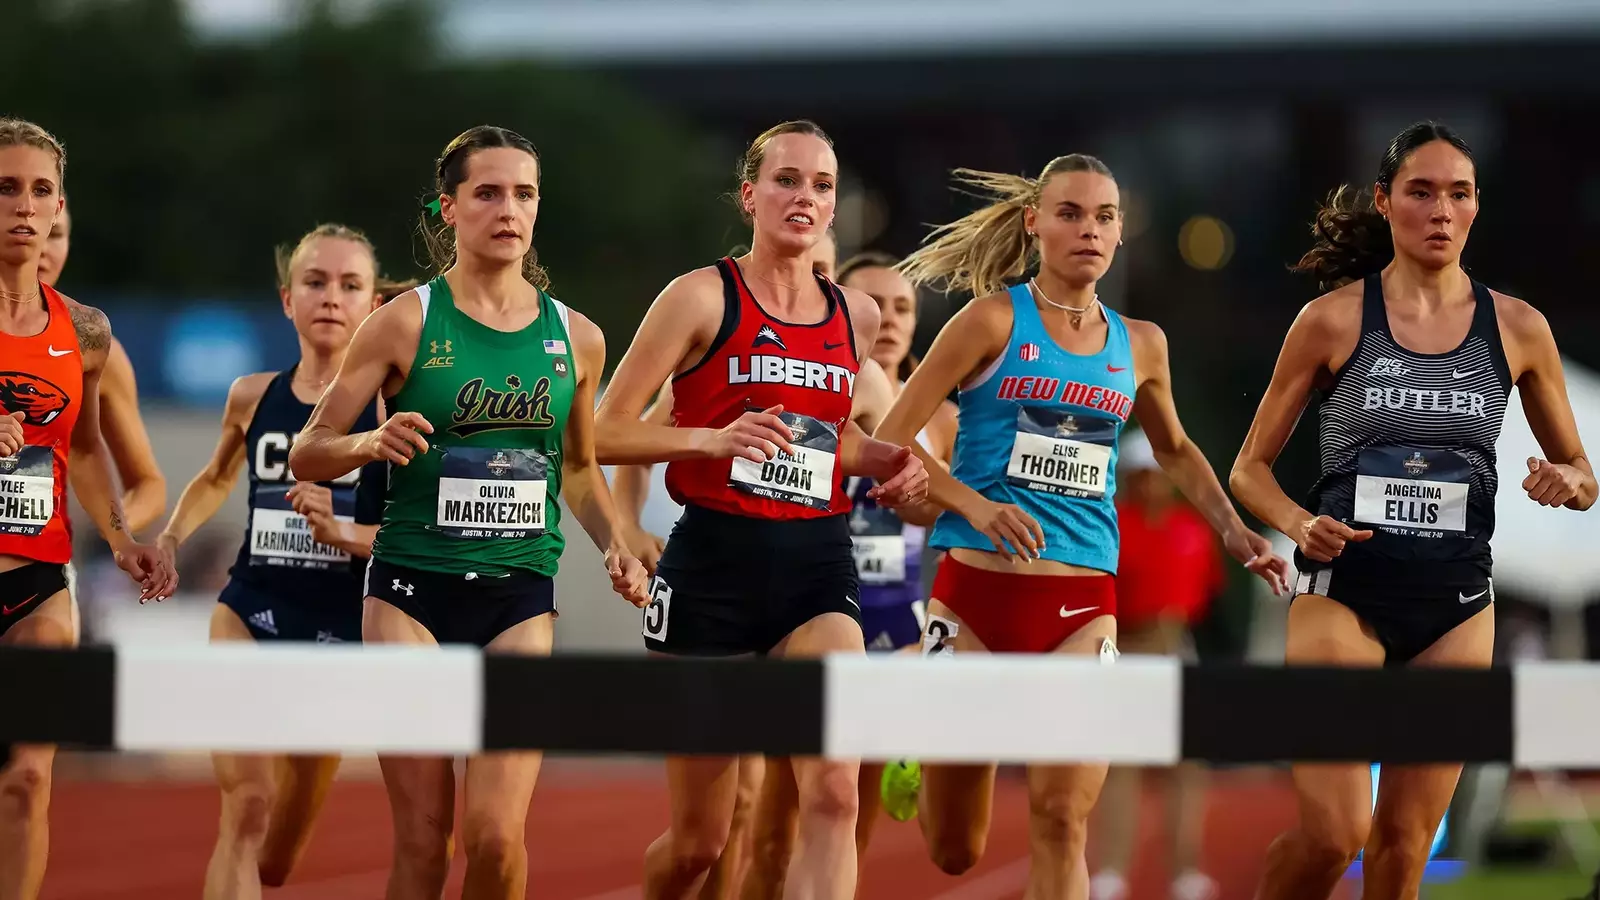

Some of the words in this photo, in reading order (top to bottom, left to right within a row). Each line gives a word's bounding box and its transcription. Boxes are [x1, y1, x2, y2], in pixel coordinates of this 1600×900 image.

[424, 356, 455, 367] ACC
[555, 363, 566, 372] AB
[1375, 357, 1403, 367] BIG
[728, 355, 856, 398] LIBERTY
[1370, 366, 1410, 375] EAST
[997, 375, 1060, 400] NEW
[450, 376, 555, 426] Irish
[1363, 387, 1486, 418] BUTLER
[1052, 444, 1080, 458] ELISE
[760, 461, 813, 490] DOAN
[1020, 454, 1100, 485] THORNER
[1, 480, 25, 493] YLEE
[479, 486, 515, 499] OLIVIA
[1384, 484, 1442, 500] ANGELINA
[444, 500, 541, 523] MARKEZICH
[1385, 500, 1439, 524] ELLIS
[8, 526, 22, 534] JUNE
[461, 529, 483, 537] AUSTIN,
[1379, 526, 1399, 535] STIN,
[1417, 530, 1431, 538] JUNE
[646, 580, 668, 634] 5
[928, 620, 950, 657] 2
